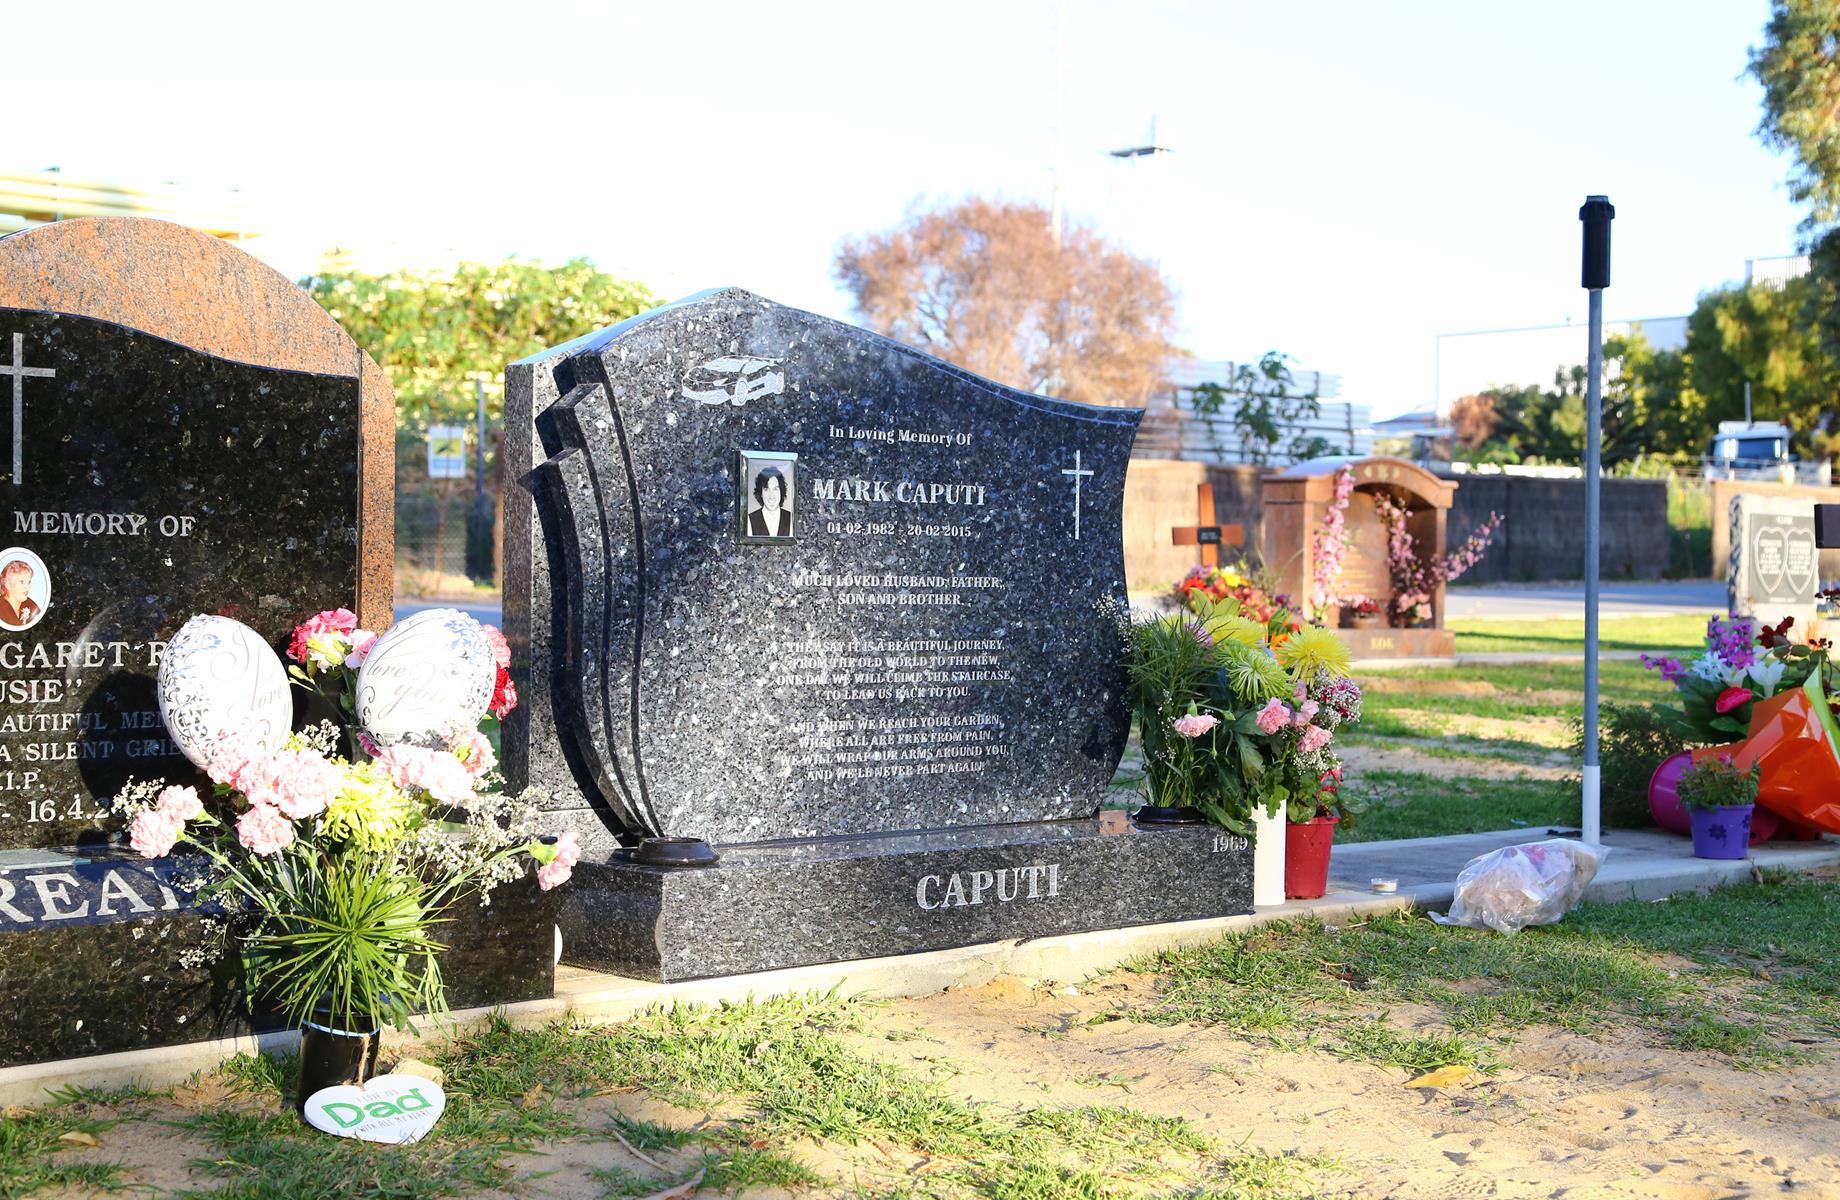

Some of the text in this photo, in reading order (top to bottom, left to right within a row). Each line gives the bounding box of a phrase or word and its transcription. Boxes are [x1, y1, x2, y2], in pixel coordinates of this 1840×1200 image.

[828, 424, 973, 448] In Loving Memory Of
[813, 478, 986, 506] MARK CAPUTI
[13, 511, 197, 537] MEMORY OF
[826, 521, 895, 535] 01-02-1982
[907, 524, 972, 537] 20-02-2015
[791, 574, 832, 588] MUCH
[836, 574, 881, 587] LOVED
[838, 593, 865, 606] SON
[867, 593, 896, 606] AND
[786, 641, 822, 654] THEY
[823, 641, 846, 654] SAY
[876, 639, 886, 652] A
[888, 640, 952, 652] BEAUTIFUL
[793, 657, 828, 670] FROM
[832, 657, 856, 669] THE
[858, 657, 883, 668] OLD
[886, 655, 929, 668] WORLD
[930, 655, 947, 668] TO
[948, 655, 971, 667] THE
[777, 674, 803, 686] ONE
[805, 673, 830, 686] DAY
[832, 673, 852, 685] WE
[854, 672, 885, 685] WILL
[886, 671, 923, 684] CLIMB
[925, 670, 949, 683] THE
[823, 689, 841, 702] TO
[843, 689, 876, 701] LEAD
[877, 687, 893, 700] US
[895, 687, 926, 700] BACK
[927, 686, 944, 699] TO
[0, 711, 108, 733] AUTIFUL
[788, 719, 815, 733] AND
[818, 719, 854, 732] WHEN
[858, 719, 876, 730] WE
[878, 717, 918, 730] REACH
[919, 716, 951, 729] YOUR
[799, 735, 844, 748] WHERE
[846, 735, 869, 746] ALL
[871, 733, 895, 745] ARE
[897, 732, 928, 744] FREE
[930, 731, 962, 743] FROM
[26, 741, 114, 762] SILENT
[126, 738, 182, 758] GRIE
[780, 753, 801, 766] WE
[803, 752, 833, 765] WILL
[836, 751, 870, 763] WRAP
[873, 749, 898, 761] OUR
[900, 747, 934, 760] ARMS
[936, 745, 983, 758] AROUND
[807, 769, 833, 781] AND
[874, 765, 914, 778] NEVER
[916, 763, 946, 775] PART
[27, 794, 113, 823] 16.4.2
[916, 863, 1060, 910] CAPUTI
[321, 1087, 433, 1128] Dad
